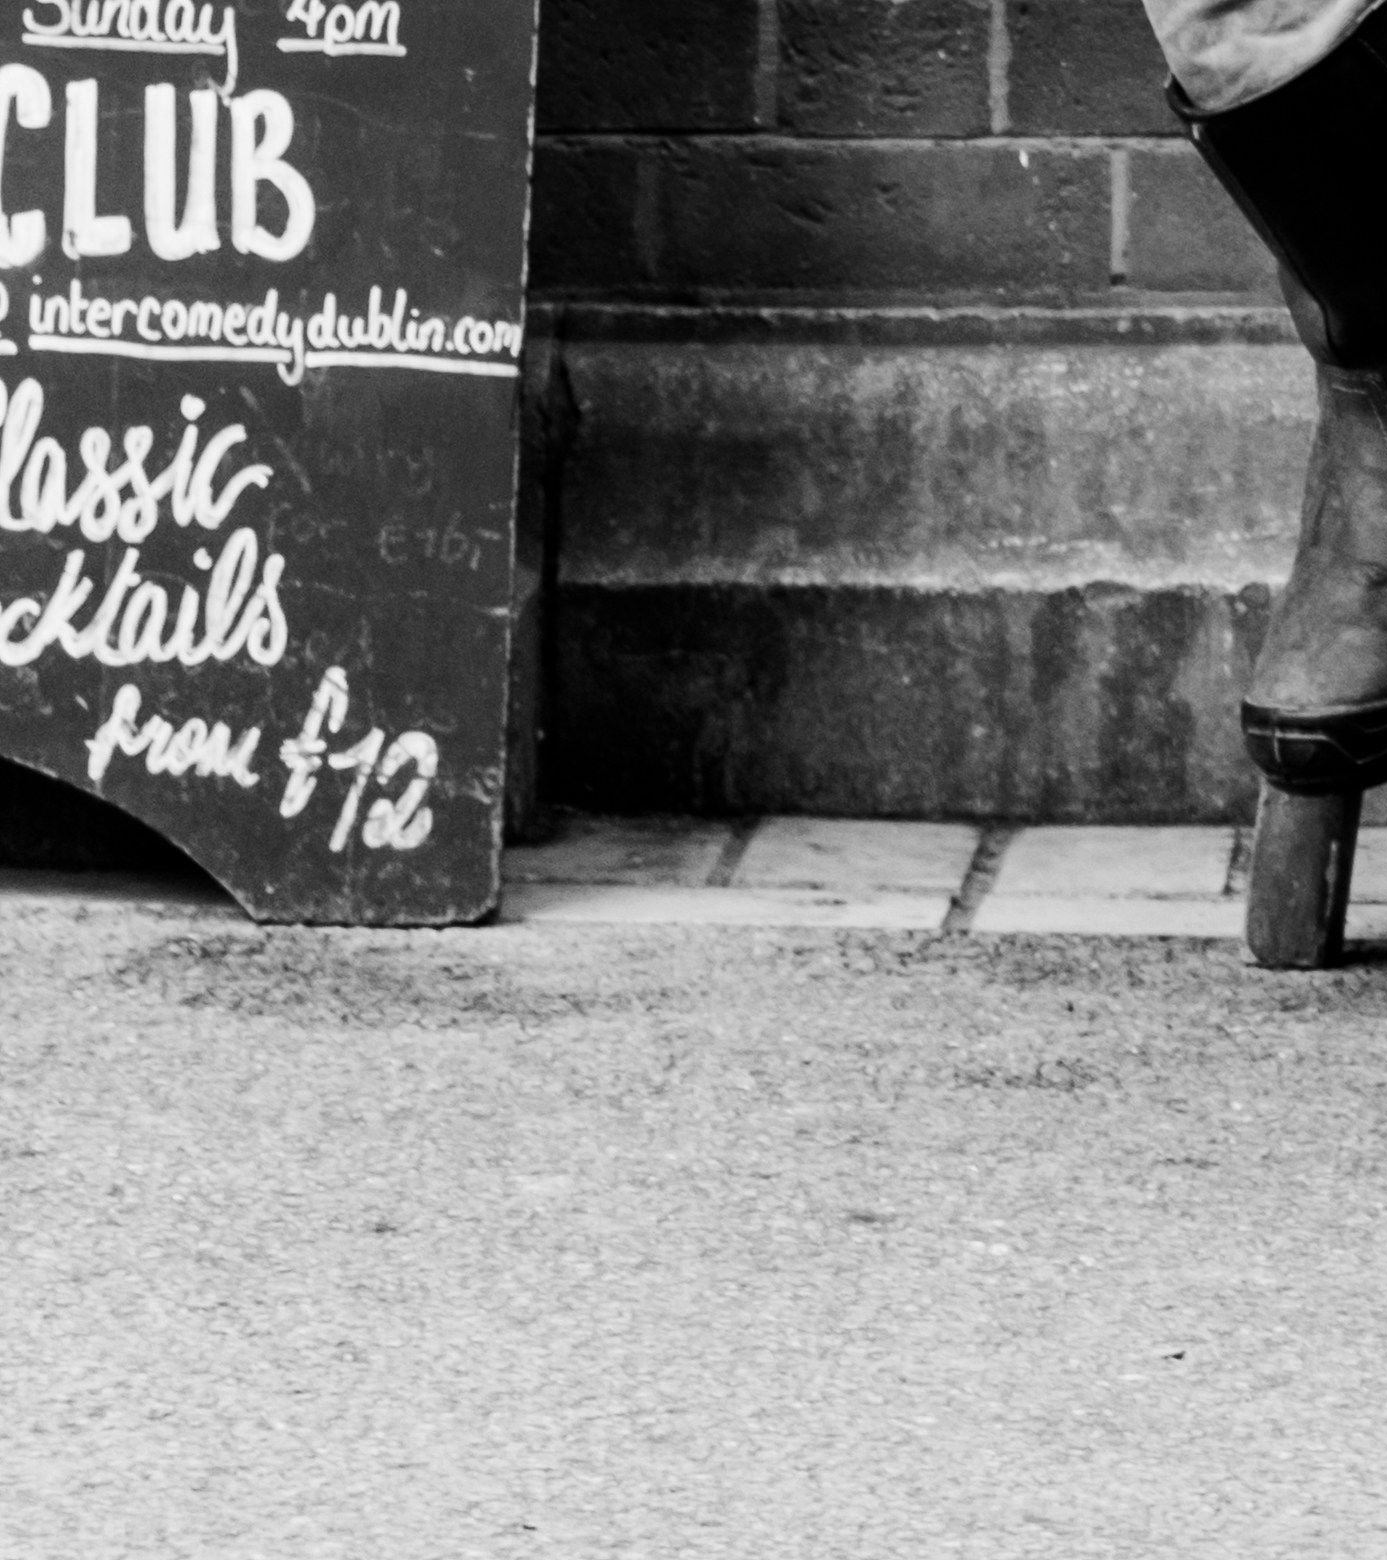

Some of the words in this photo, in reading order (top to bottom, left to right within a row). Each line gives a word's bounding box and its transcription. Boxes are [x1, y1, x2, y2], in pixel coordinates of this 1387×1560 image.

[0, 62, 315, 269] CLUB
[29, 275, 522, 386] intercomedydublin.com
[0, 377, 274, 544] lassic
[84, 683, 261, 788] from
